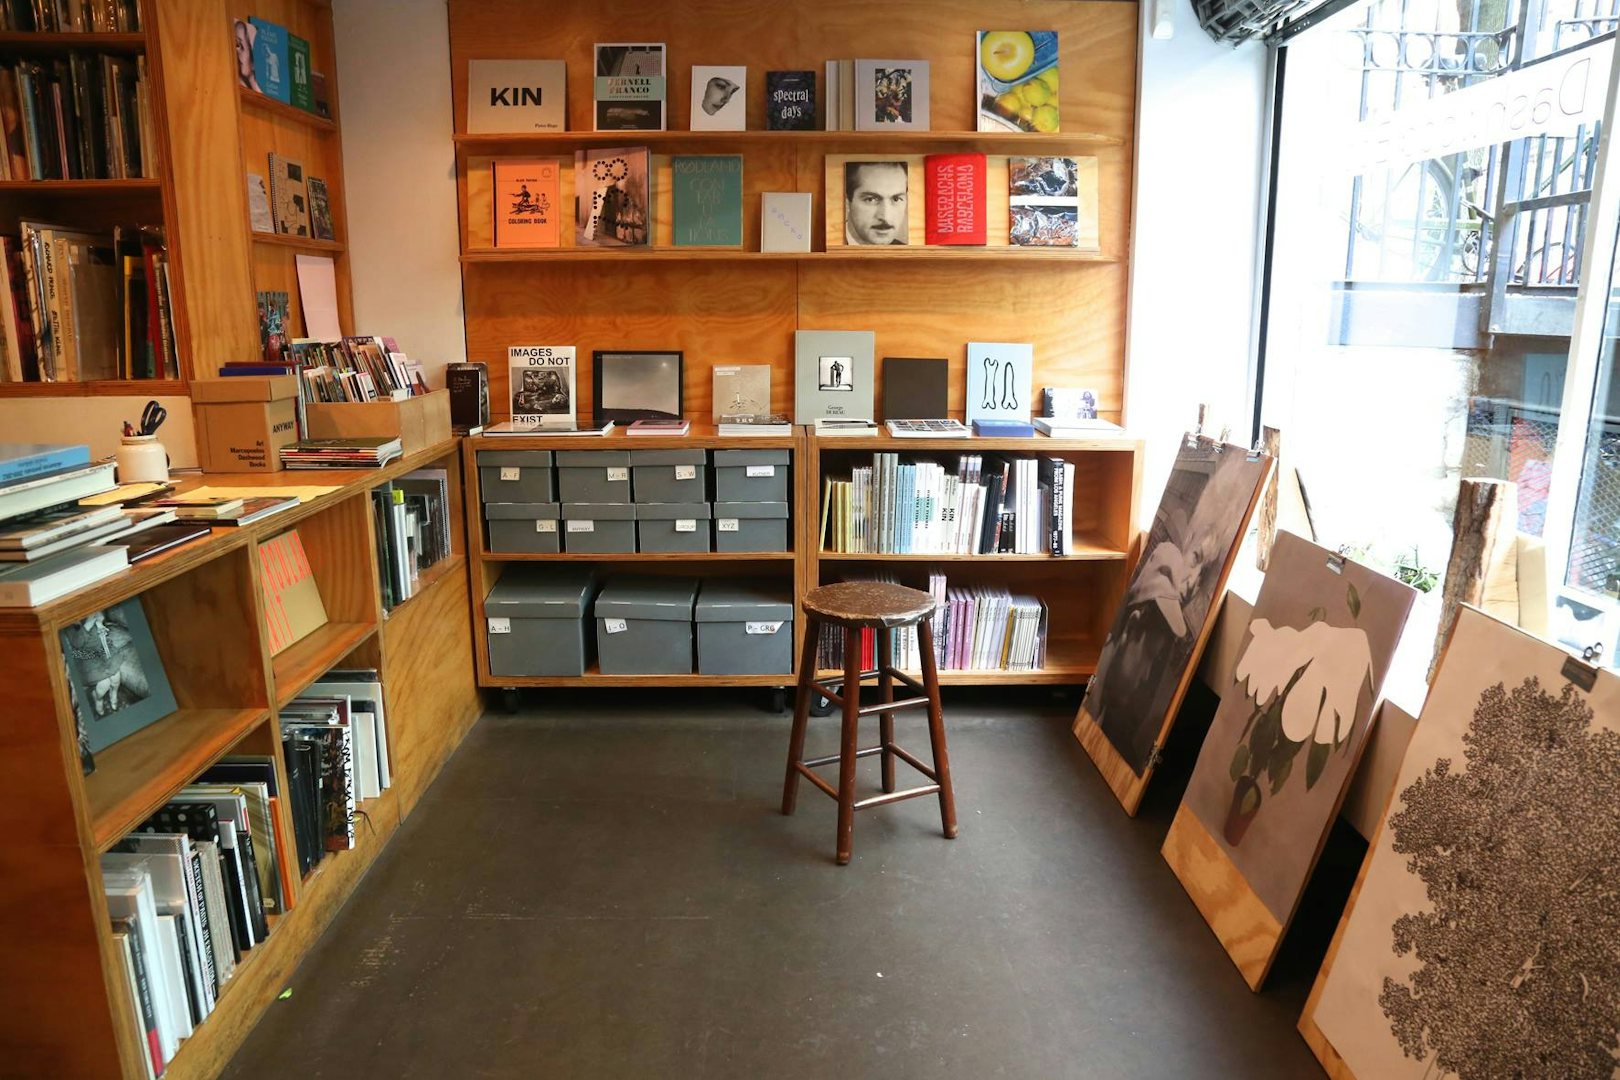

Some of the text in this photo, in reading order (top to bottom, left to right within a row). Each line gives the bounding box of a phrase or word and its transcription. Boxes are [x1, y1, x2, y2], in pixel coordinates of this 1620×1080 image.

[490, 87, 542, 106] KIN
[773, 89, 809, 103] spectral
[781, 105, 802, 119] days
[510, 348, 552, 357] IMAGES
[528, 357, 571, 366] DO NOT
[512, 415, 543, 424] EXIST
[272, 420, 294, 434] ANYWAY
[193, 858, 202, 892] SKETCH
[200, 900, 208, 928] PARIS
